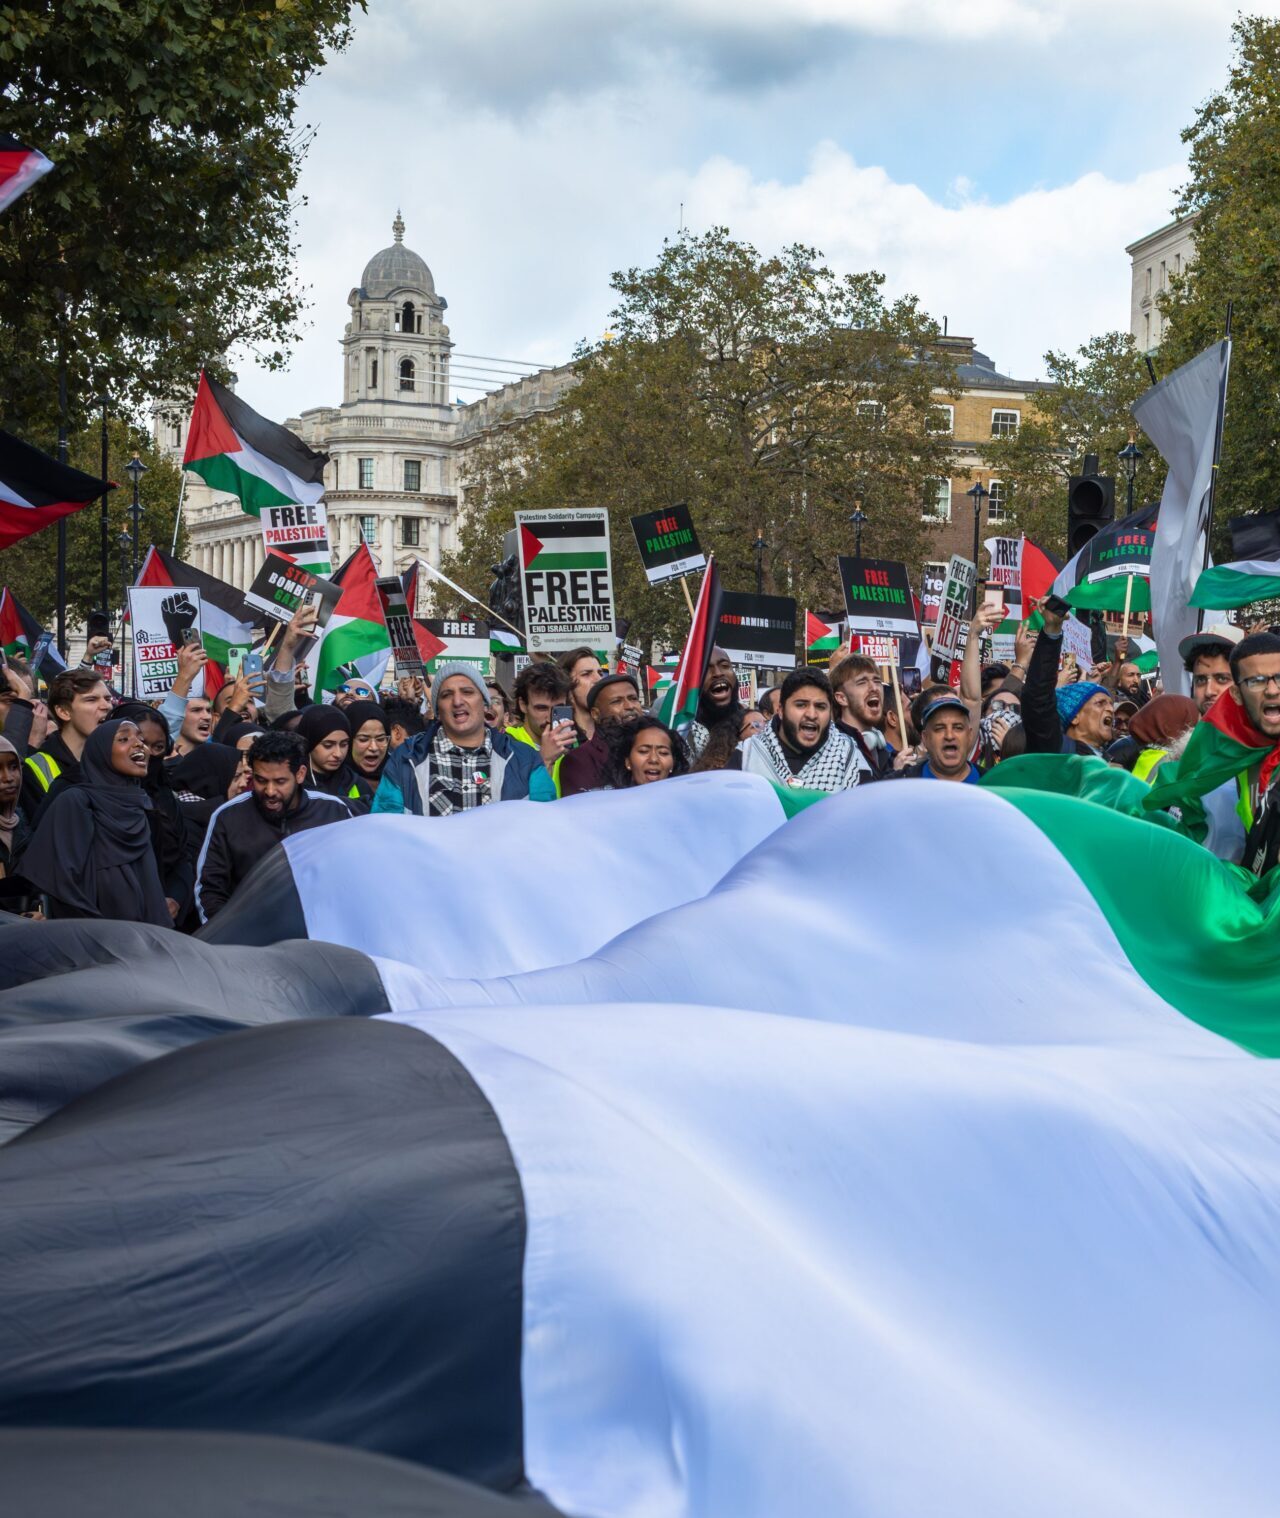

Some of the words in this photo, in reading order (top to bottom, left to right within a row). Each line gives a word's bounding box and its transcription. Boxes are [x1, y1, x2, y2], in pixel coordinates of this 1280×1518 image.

[269, 505, 318, 528] FREE
[519, 513, 547, 522] Palestine
[548, 512, 575, 521] Solidarity
[575, 511, 605, 520] Campaign
[265, 525, 327, 543] PALESTINE
[655, 517, 679, 535] FREE
[645, 528, 694, 553] PALESTINE
[1117, 535, 1147, 546] FREE
[995, 538, 1018, 568] FREE
[1099, 544, 1153, 562] PALESTI
[285, 566, 317, 588] STOP
[864, 568, 890, 586] FREE
[950, 559, 967, 580] FREE
[268, 571, 309, 599] BOMBI
[525, 570, 611, 606] FREE
[852, 584, 906, 604] PALESTINE
[274, 588, 301, 609] GAZ
[527, 605, 612, 623] PALESTINE
[386, 616, 417, 648] FREE
[443, 622, 476, 636] FREE
[532, 624, 547, 633] END
[547, 624, 574, 633] ISRAELI
[574, 623, 610, 632] APARTHEID
[863, 644, 898, 658] TERRR
[143, 677, 176, 693] RETU
